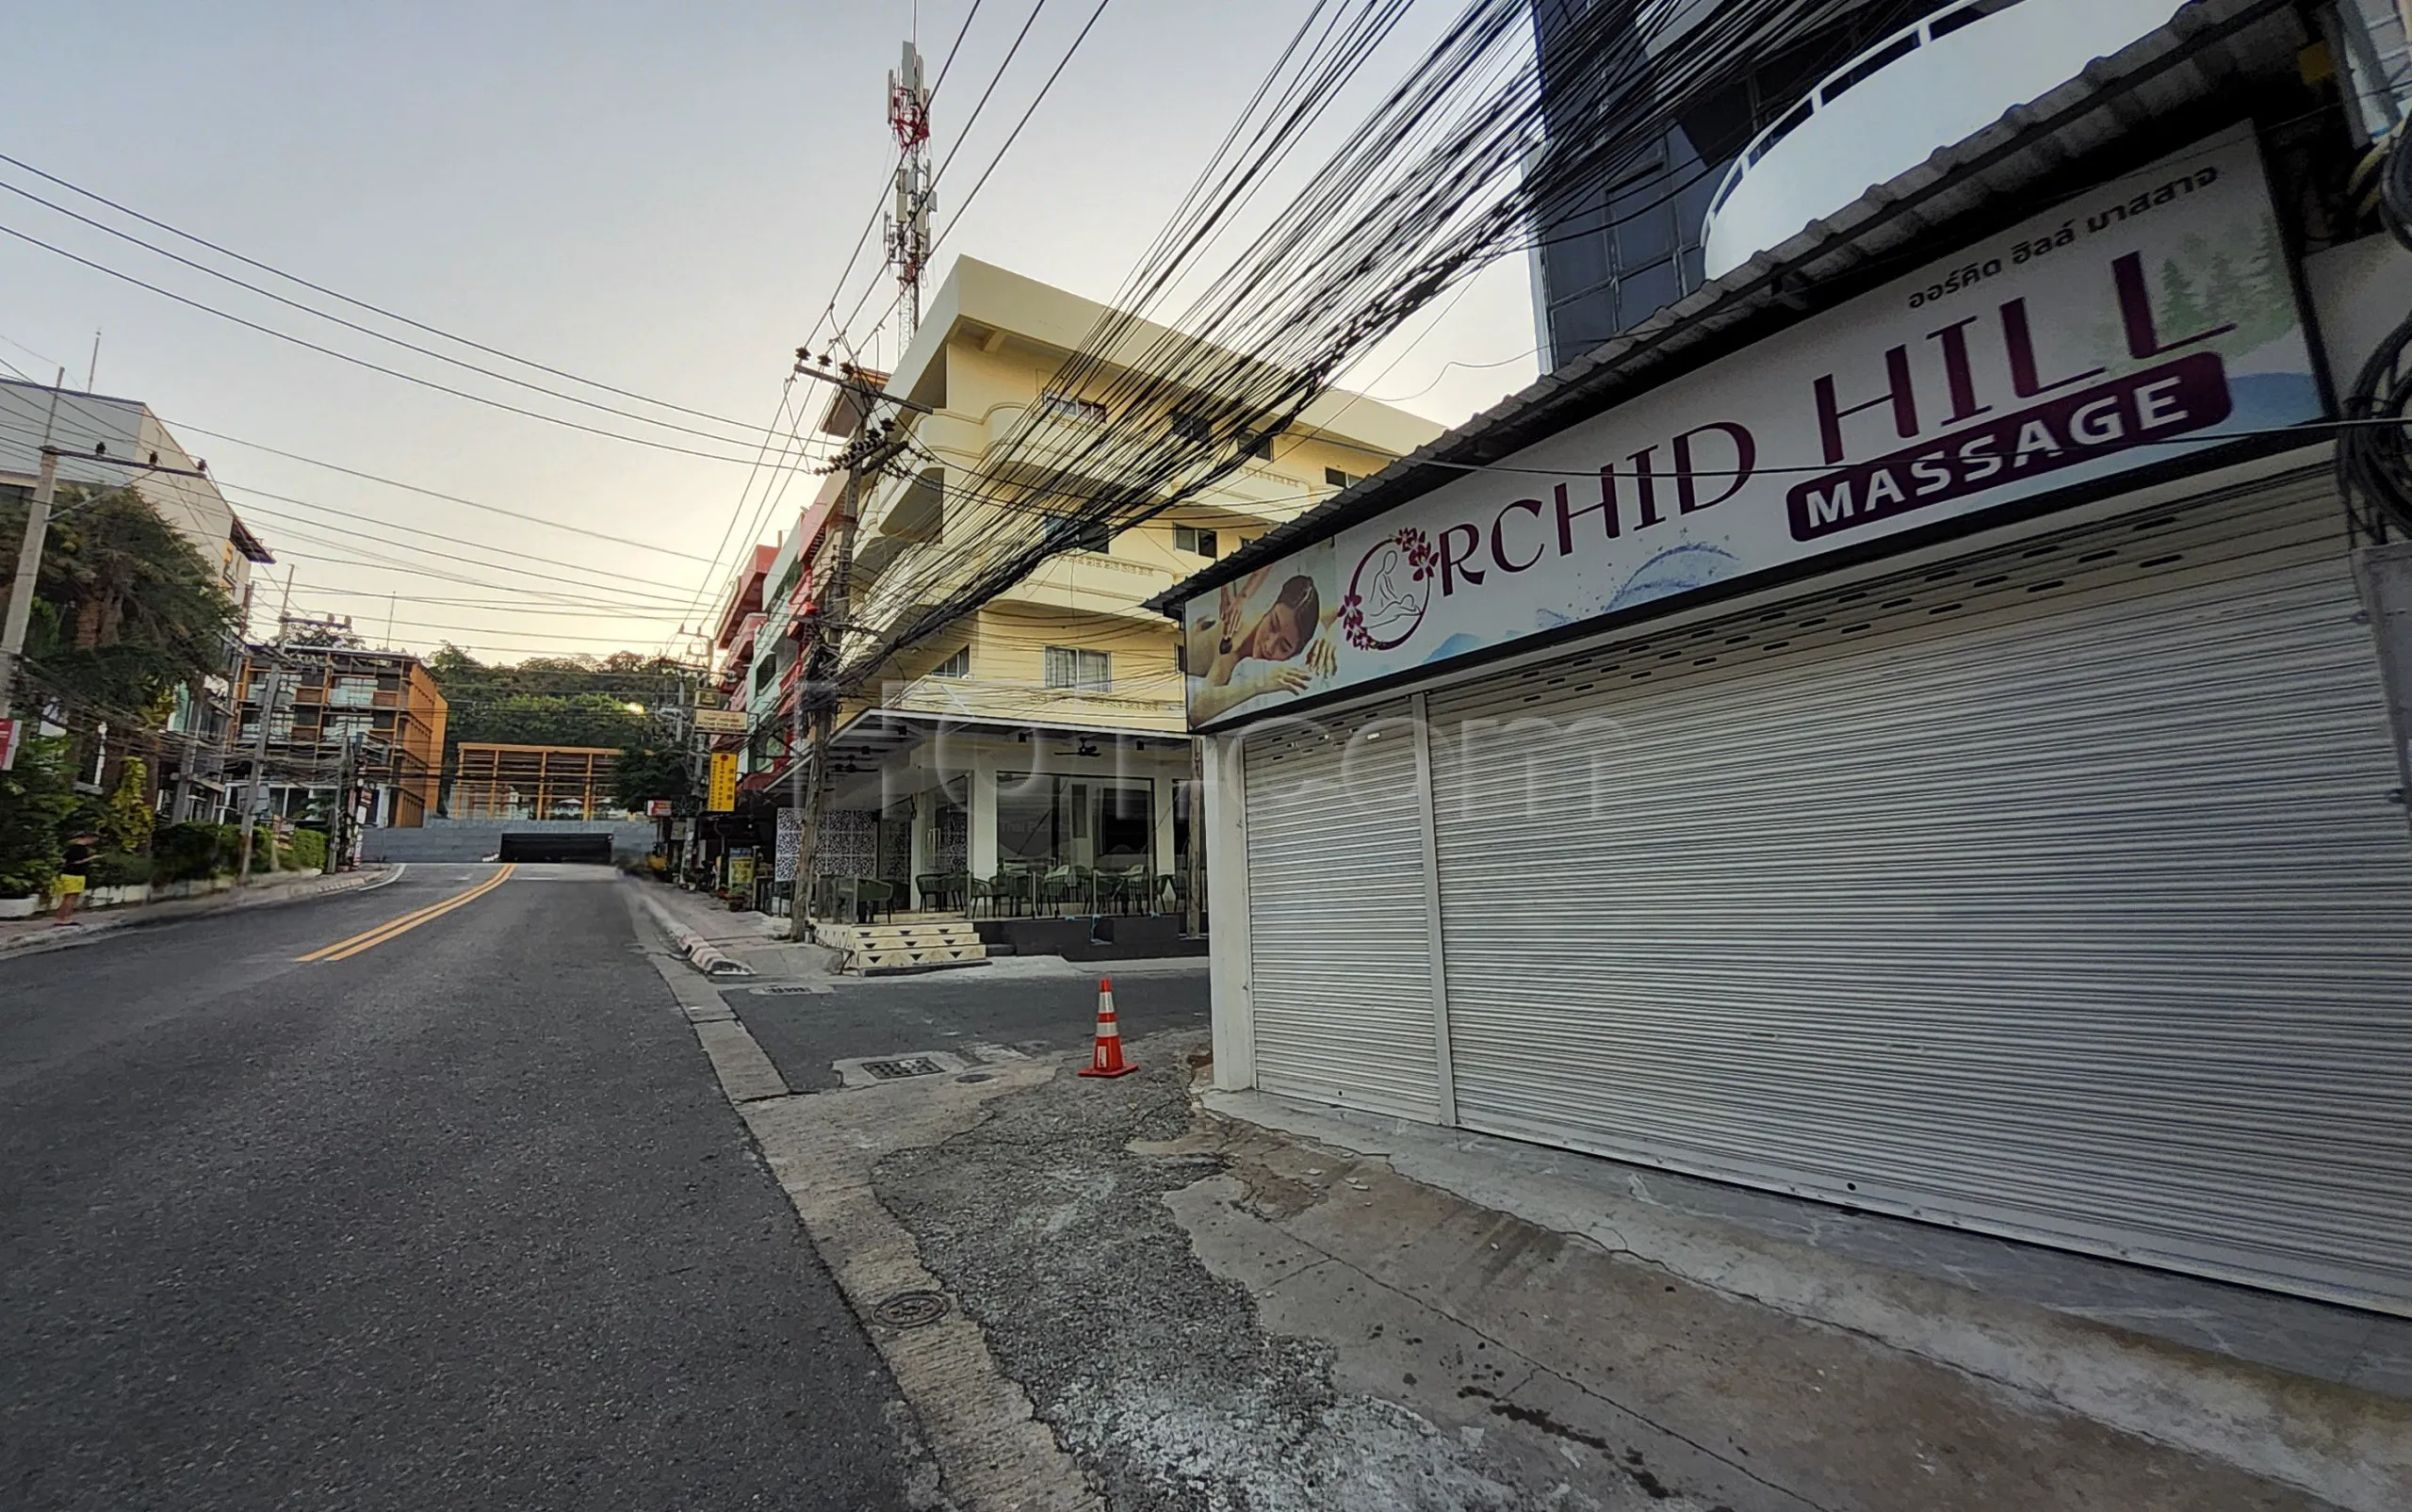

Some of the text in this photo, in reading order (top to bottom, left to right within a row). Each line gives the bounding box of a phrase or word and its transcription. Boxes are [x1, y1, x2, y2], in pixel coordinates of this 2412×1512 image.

[1812, 251, 2237, 465] HILL
[1908, 259, 2002, 309] ออร์คิด
[1804, 377, 2189, 529] MASSAGE
